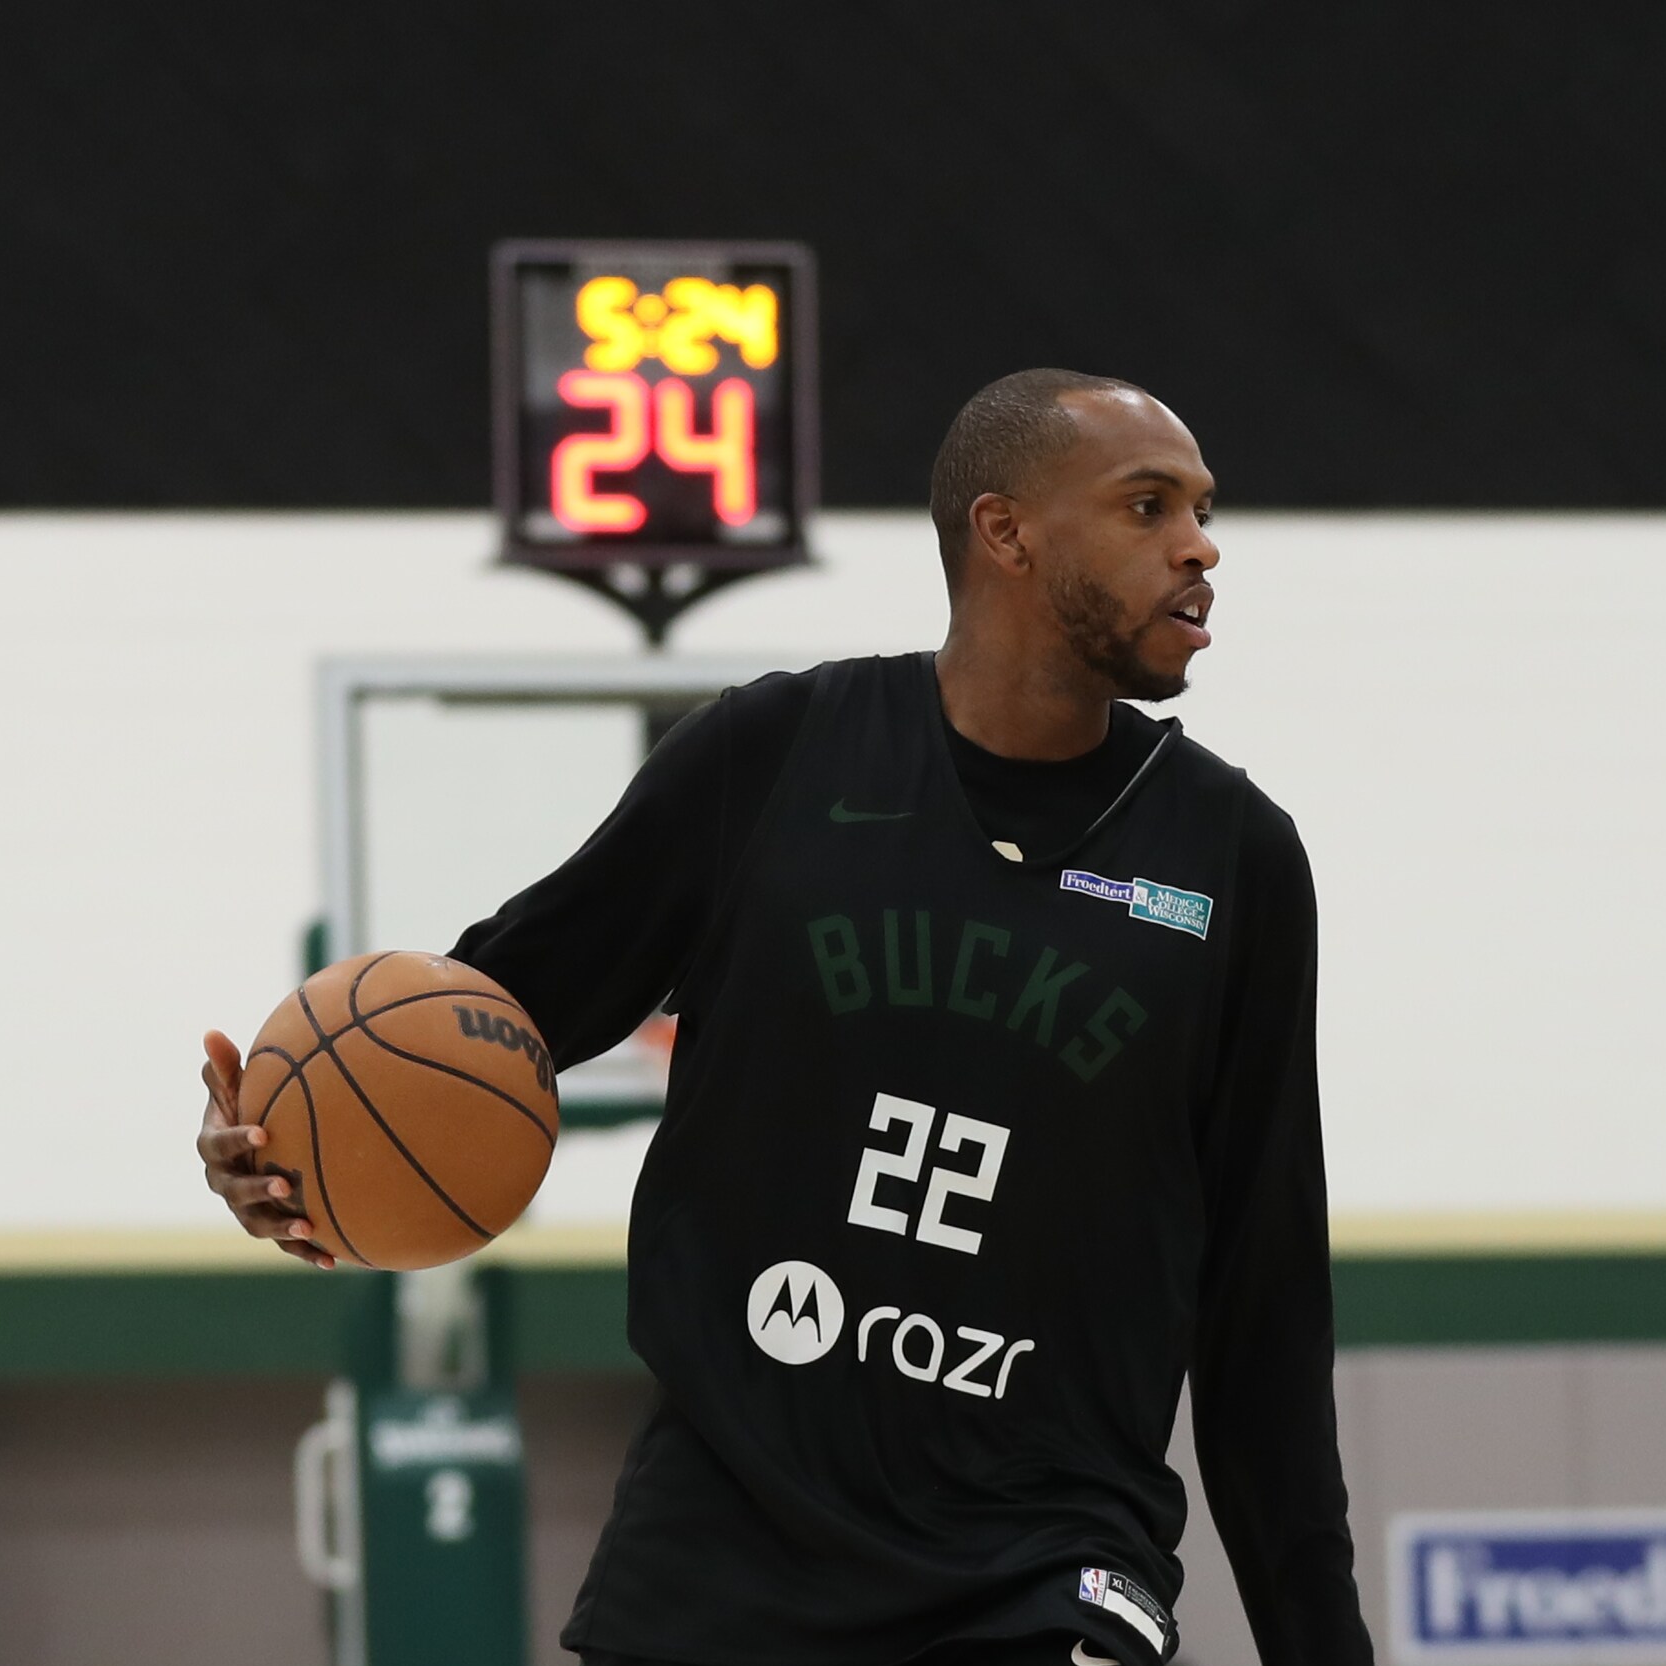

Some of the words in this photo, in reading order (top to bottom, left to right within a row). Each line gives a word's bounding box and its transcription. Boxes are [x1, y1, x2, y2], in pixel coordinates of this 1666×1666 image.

[576, 276, 778, 375] 5:24
[551, 369, 757, 533] 24
[1065, 873, 1132, 900] Froedtert
[1148, 896, 1199, 918] COLLEGE
[1156, 890, 1205, 913] MEDICAL
[1148, 904, 1205, 931] WISCONSIN
[806, 908, 1150, 1084] BUCKS
[847, 1091, 1011, 1255] 22
[857, 1305, 1035, 1400] razr
[1111, 1577, 1125, 1591] XL
